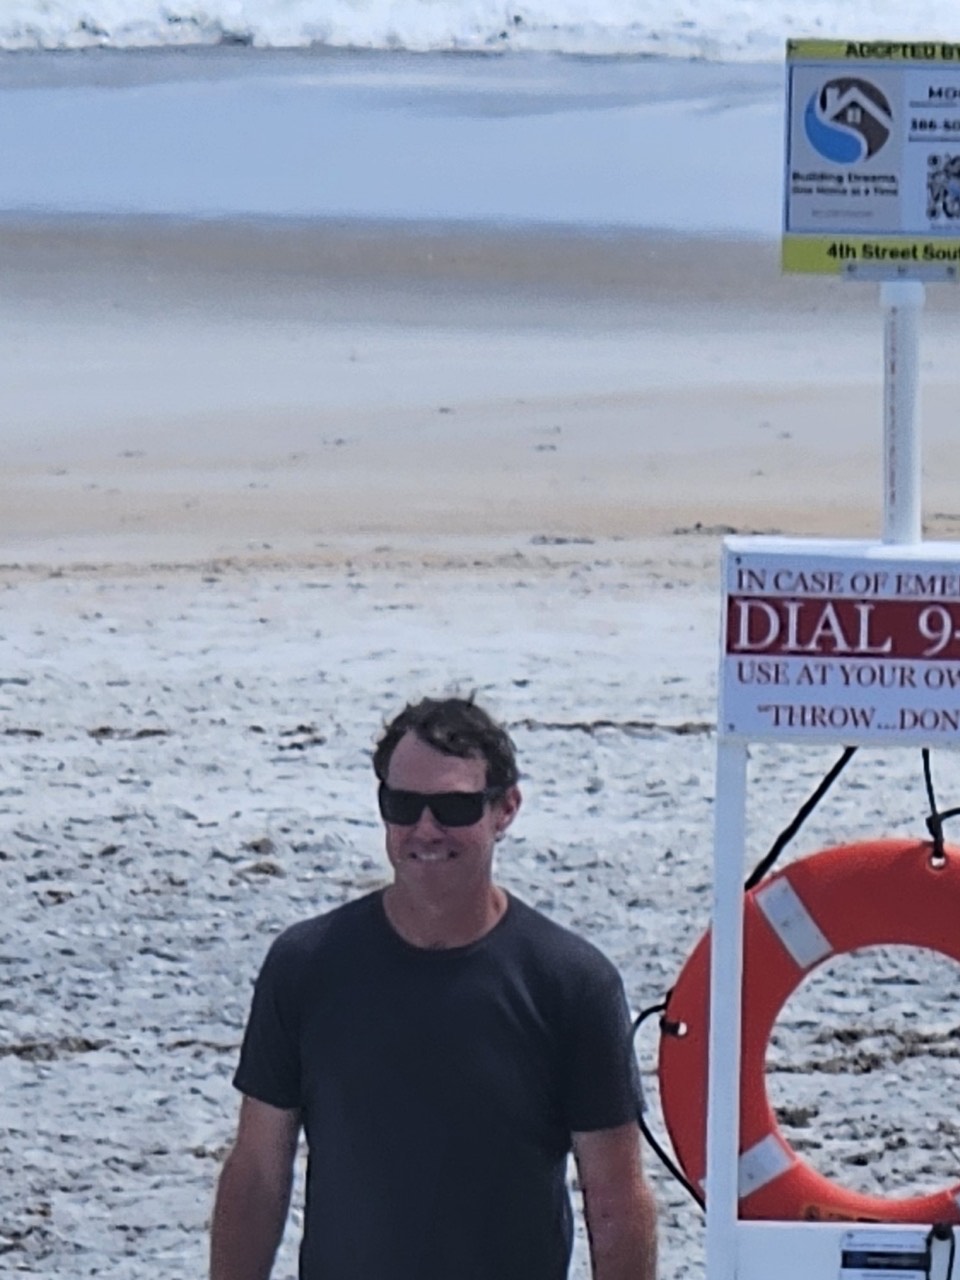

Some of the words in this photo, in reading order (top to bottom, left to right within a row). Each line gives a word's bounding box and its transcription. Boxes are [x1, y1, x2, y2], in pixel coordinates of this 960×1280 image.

[826, 243, 857, 259] 4th
[861, 243, 918, 261] Street
[736, 568, 767, 591] IN
[774, 571, 844, 593] CASE
[850, 573, 888, 594] OF
[733, 599, 893, 653] DIAL
[737, 661, 790, 686] USE
[796, 663, 834, 687] AT
[839, 664, 917, 689] YOUR
